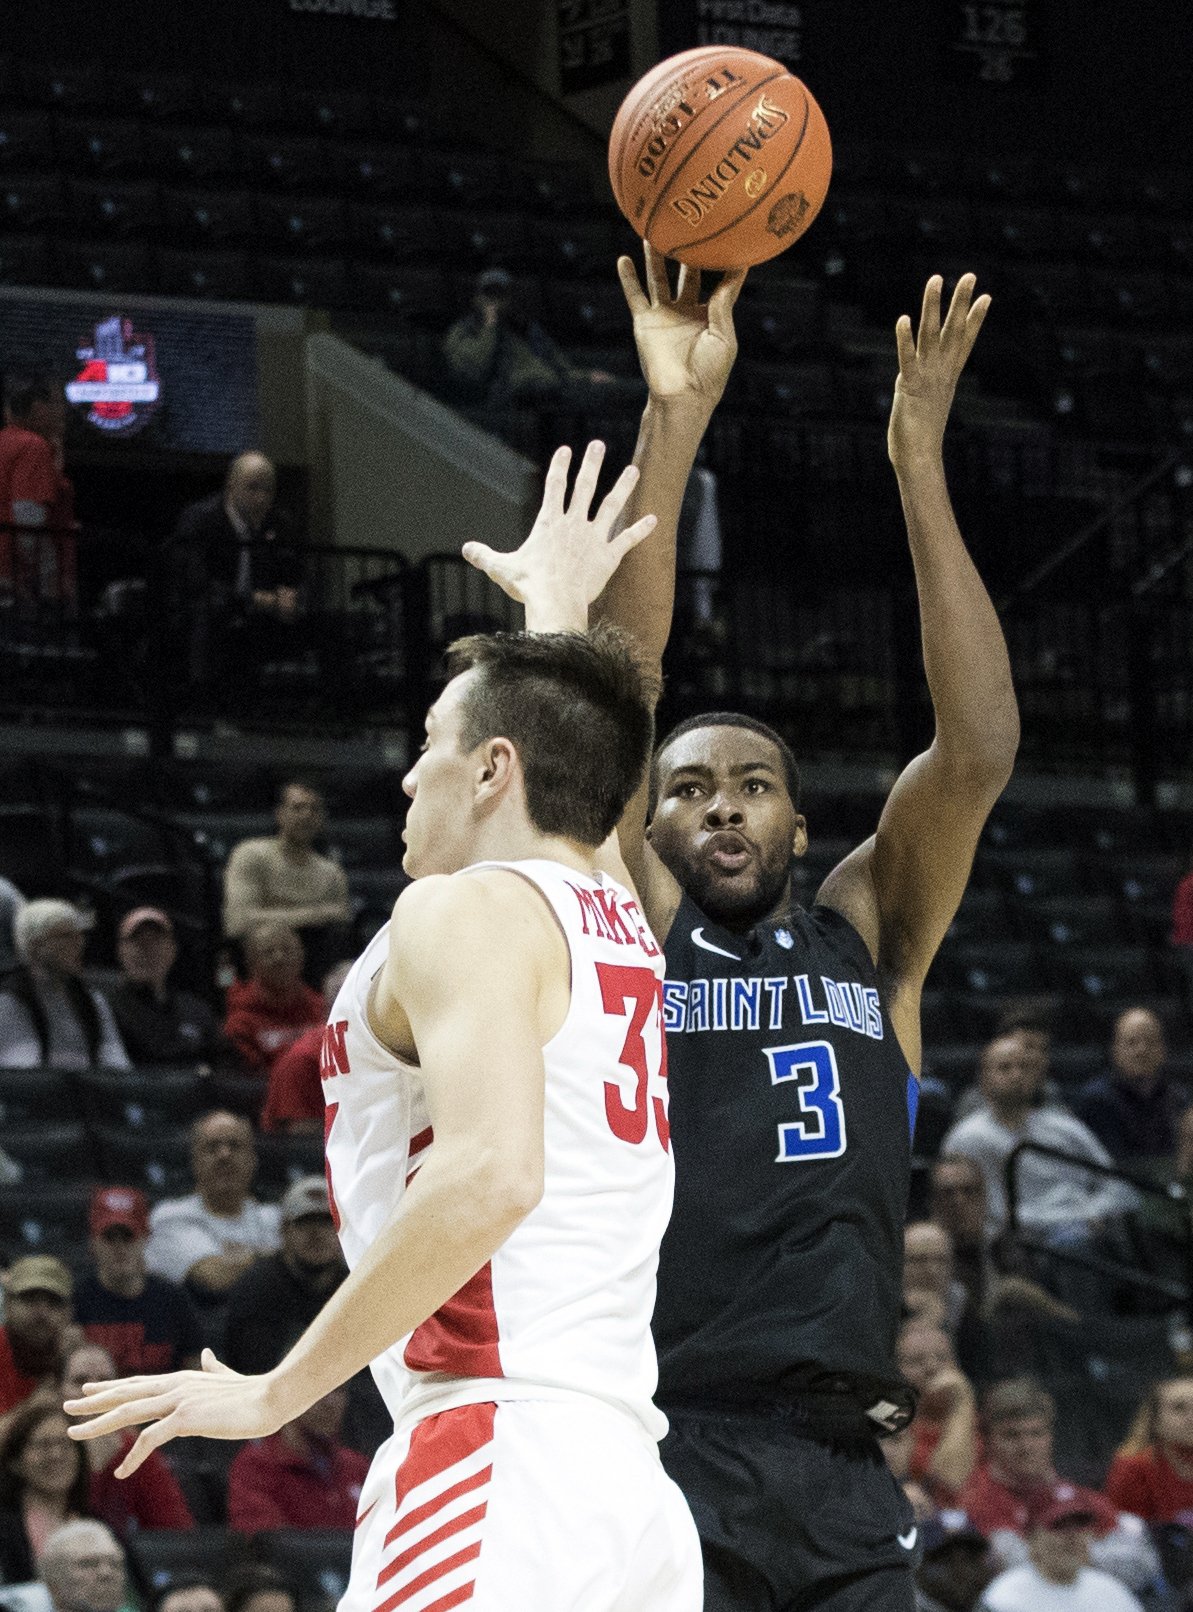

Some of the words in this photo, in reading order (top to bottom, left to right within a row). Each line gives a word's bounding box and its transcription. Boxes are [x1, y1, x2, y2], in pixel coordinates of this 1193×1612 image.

[672, 94, 790, 227] SPALDING
[662, 975, 788, 1032] SAINT
[793, 974, 883, 1040] LOUS
[761, 1040, 847, 1162] 3
